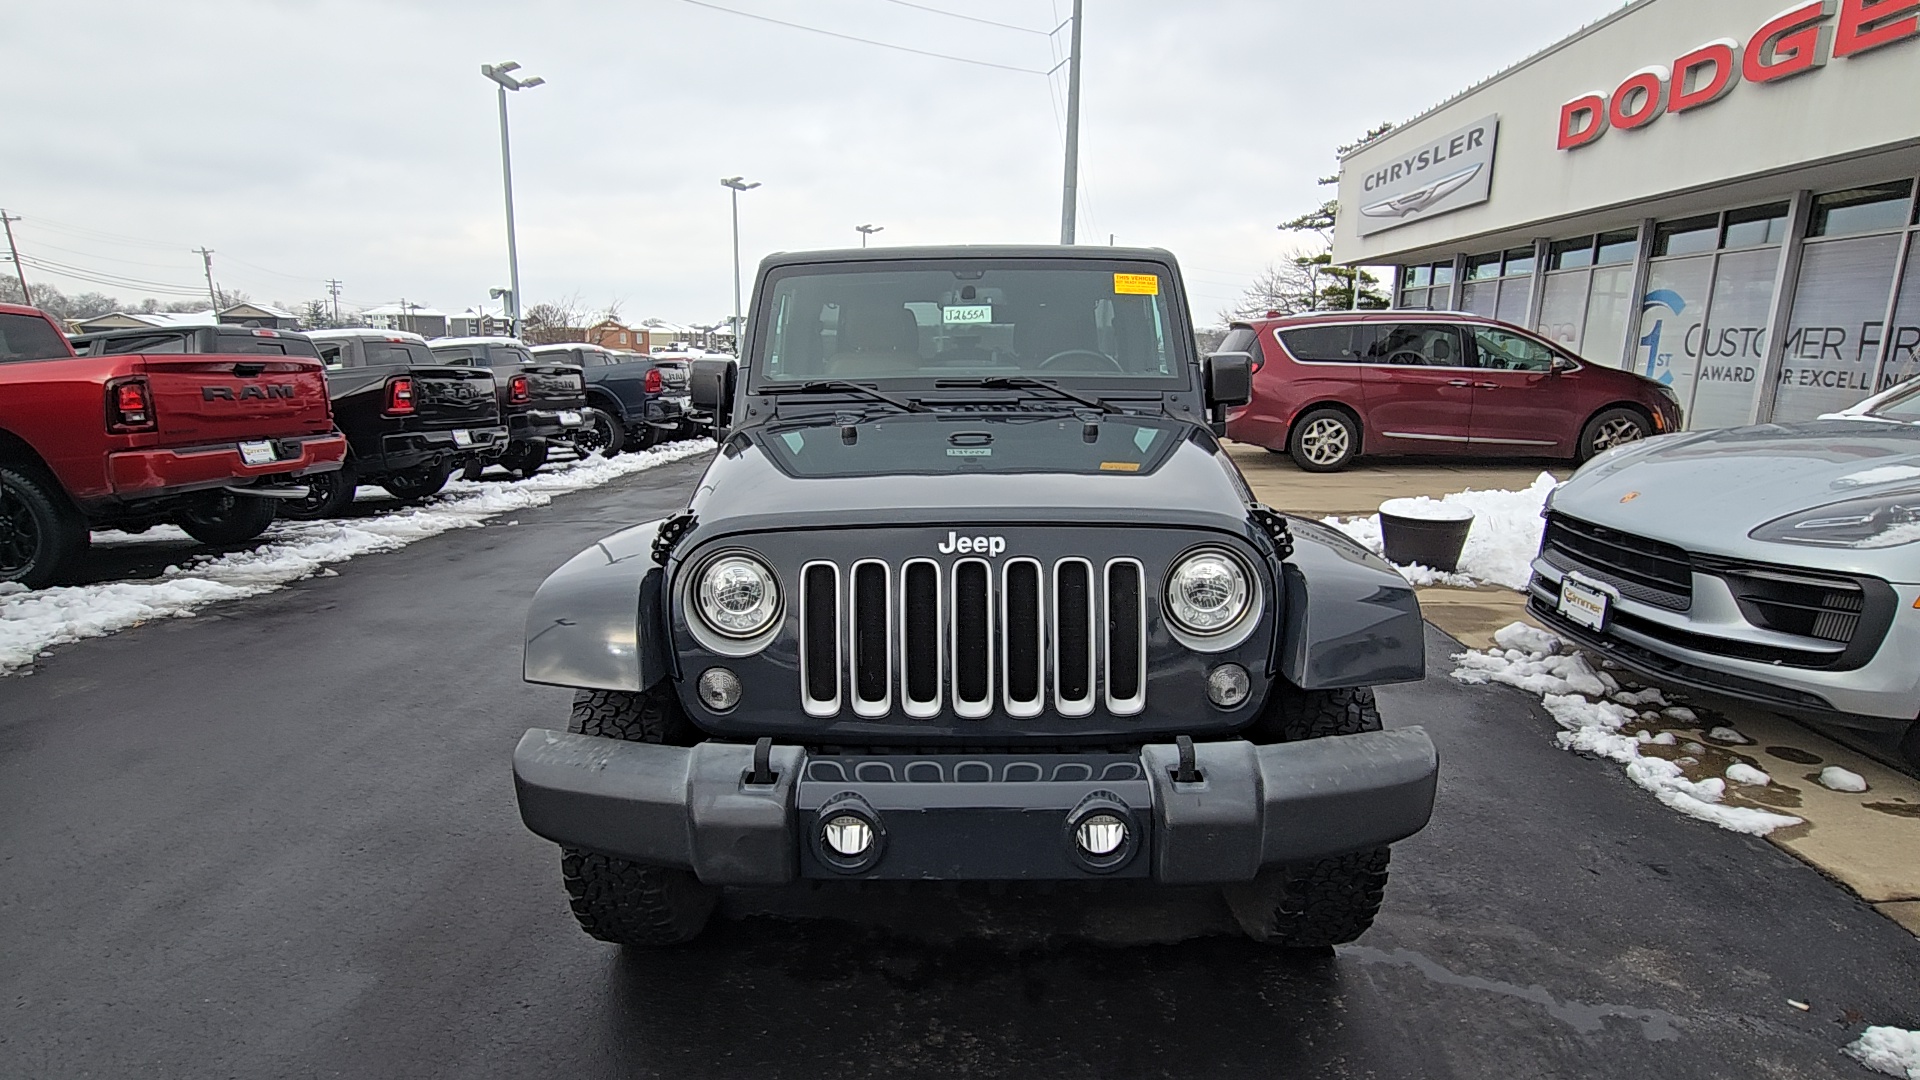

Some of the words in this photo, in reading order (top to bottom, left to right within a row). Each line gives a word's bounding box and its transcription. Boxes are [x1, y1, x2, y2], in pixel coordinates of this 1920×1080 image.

[1557, 0, 1919, 151] DODGE
[1364, 127, 1485, 192] CHRYSLER
[945, 309, 985, 321] J2655A
[1700, 365, 1755, 383] AWARD
[1798, 368, 1914, 391] EXCELLN
[203, 385, 295, 402] RAM
[938, 531, 1006, 558] Jeep
